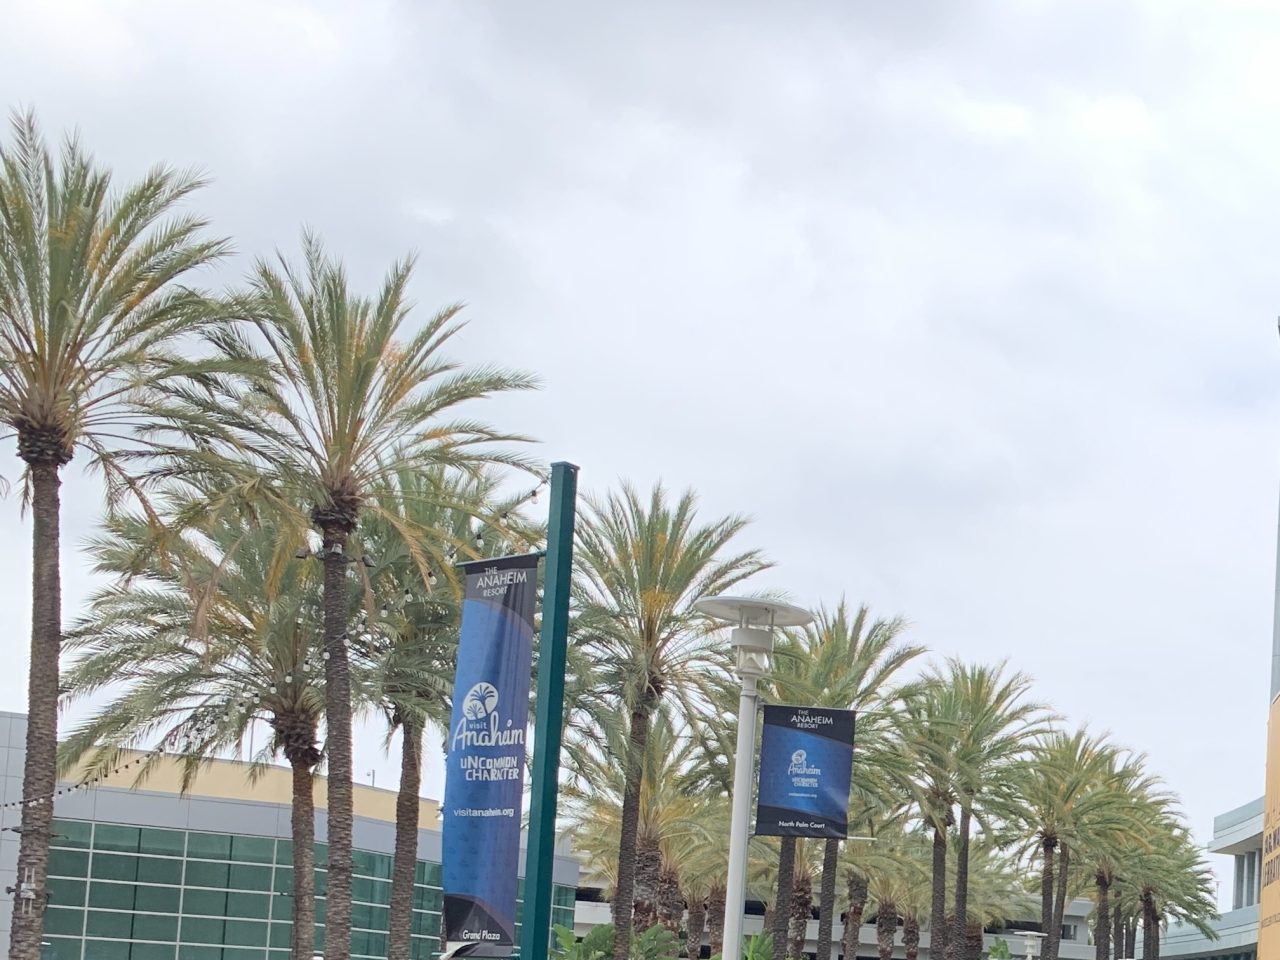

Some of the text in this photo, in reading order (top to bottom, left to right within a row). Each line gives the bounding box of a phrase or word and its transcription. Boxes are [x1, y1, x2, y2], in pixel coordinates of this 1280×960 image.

[484, 567, 498, 575] THE
[476, 571, 527, 589] ANAHEIM
[483, 586, 508, 597] RESORT
[469, 721, 487, 729] visit
[791, 715, 834, 725] ANAHEIM
[462, 929, 501, 940] Grand Plaza
